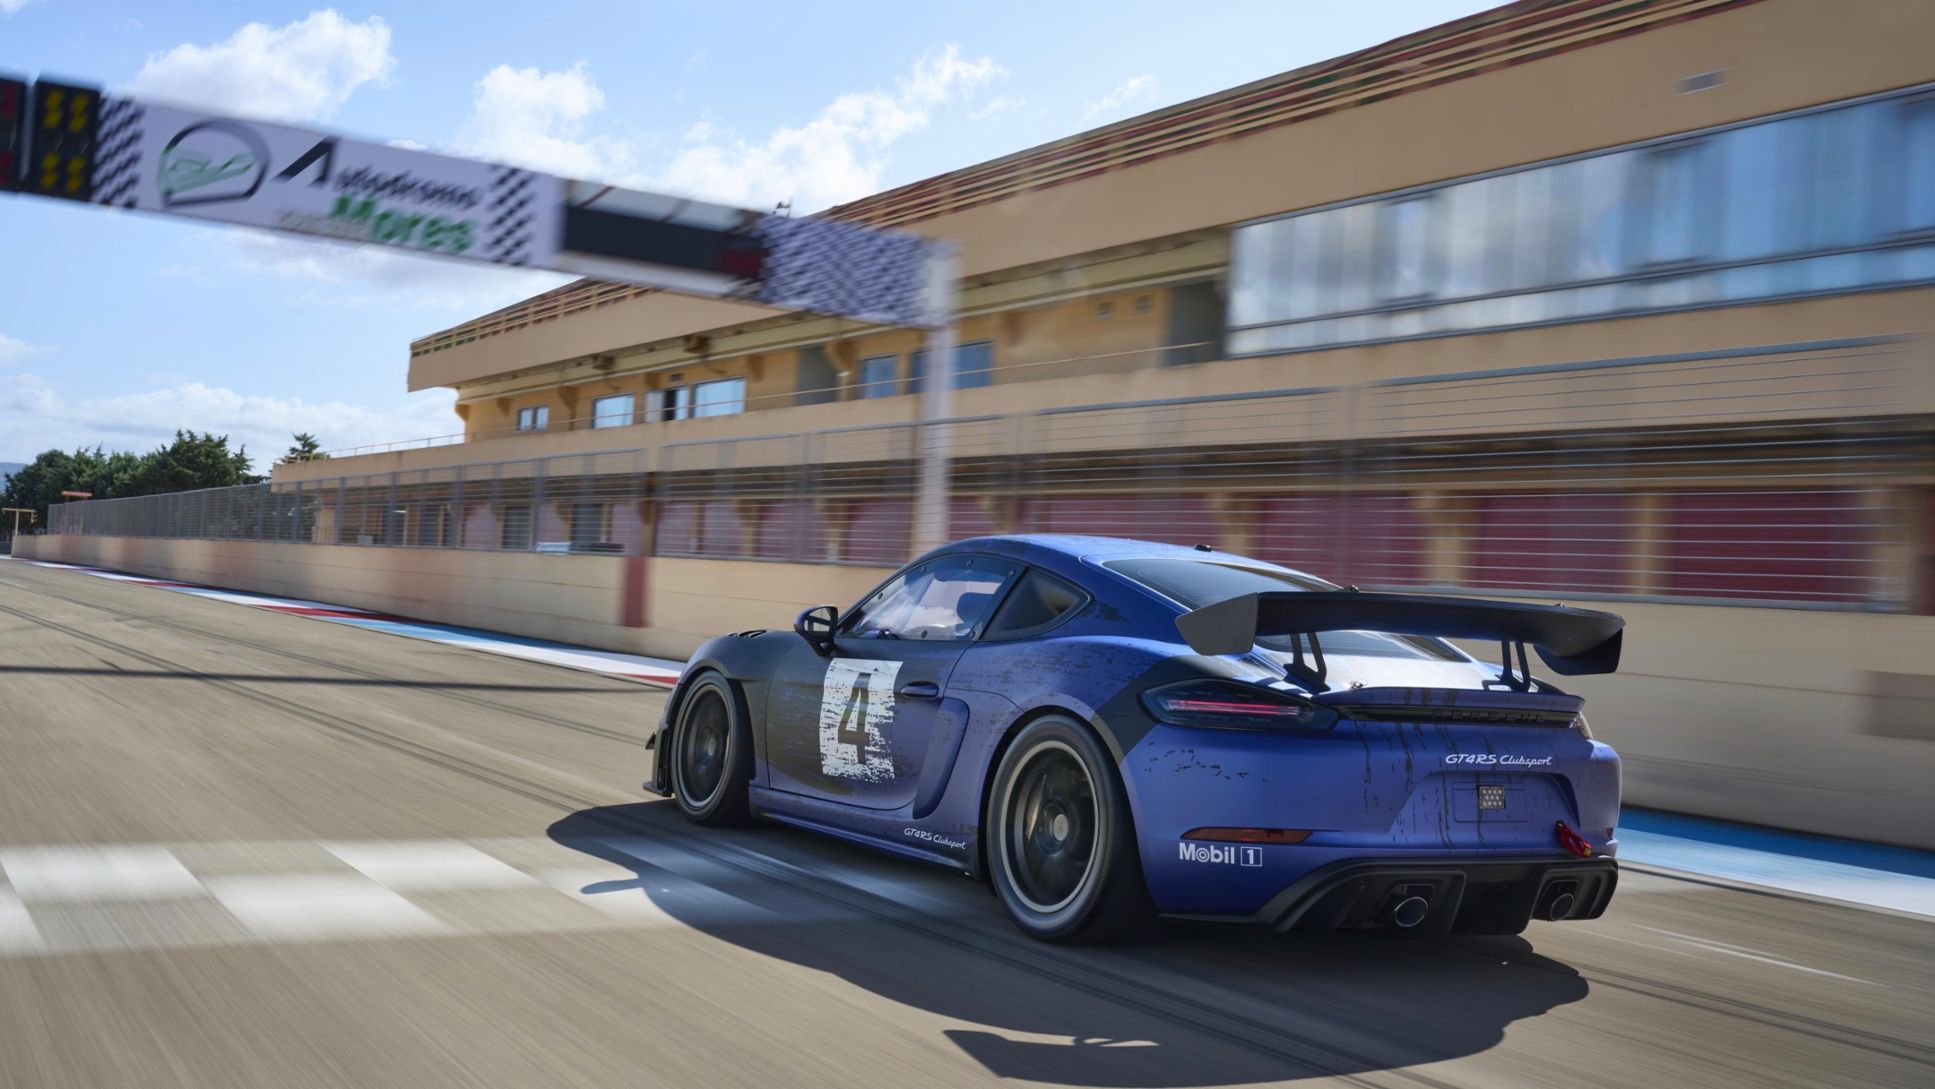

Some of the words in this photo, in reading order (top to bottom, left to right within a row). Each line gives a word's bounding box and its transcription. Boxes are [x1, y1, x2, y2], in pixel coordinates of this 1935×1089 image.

[838, 672, 872, 763] 4
[1445, 754, 1497, 764] GT4RS
[1499, 755, 1553, 768] Clubsport
[1179, 842, 1235, 864] Mobil
